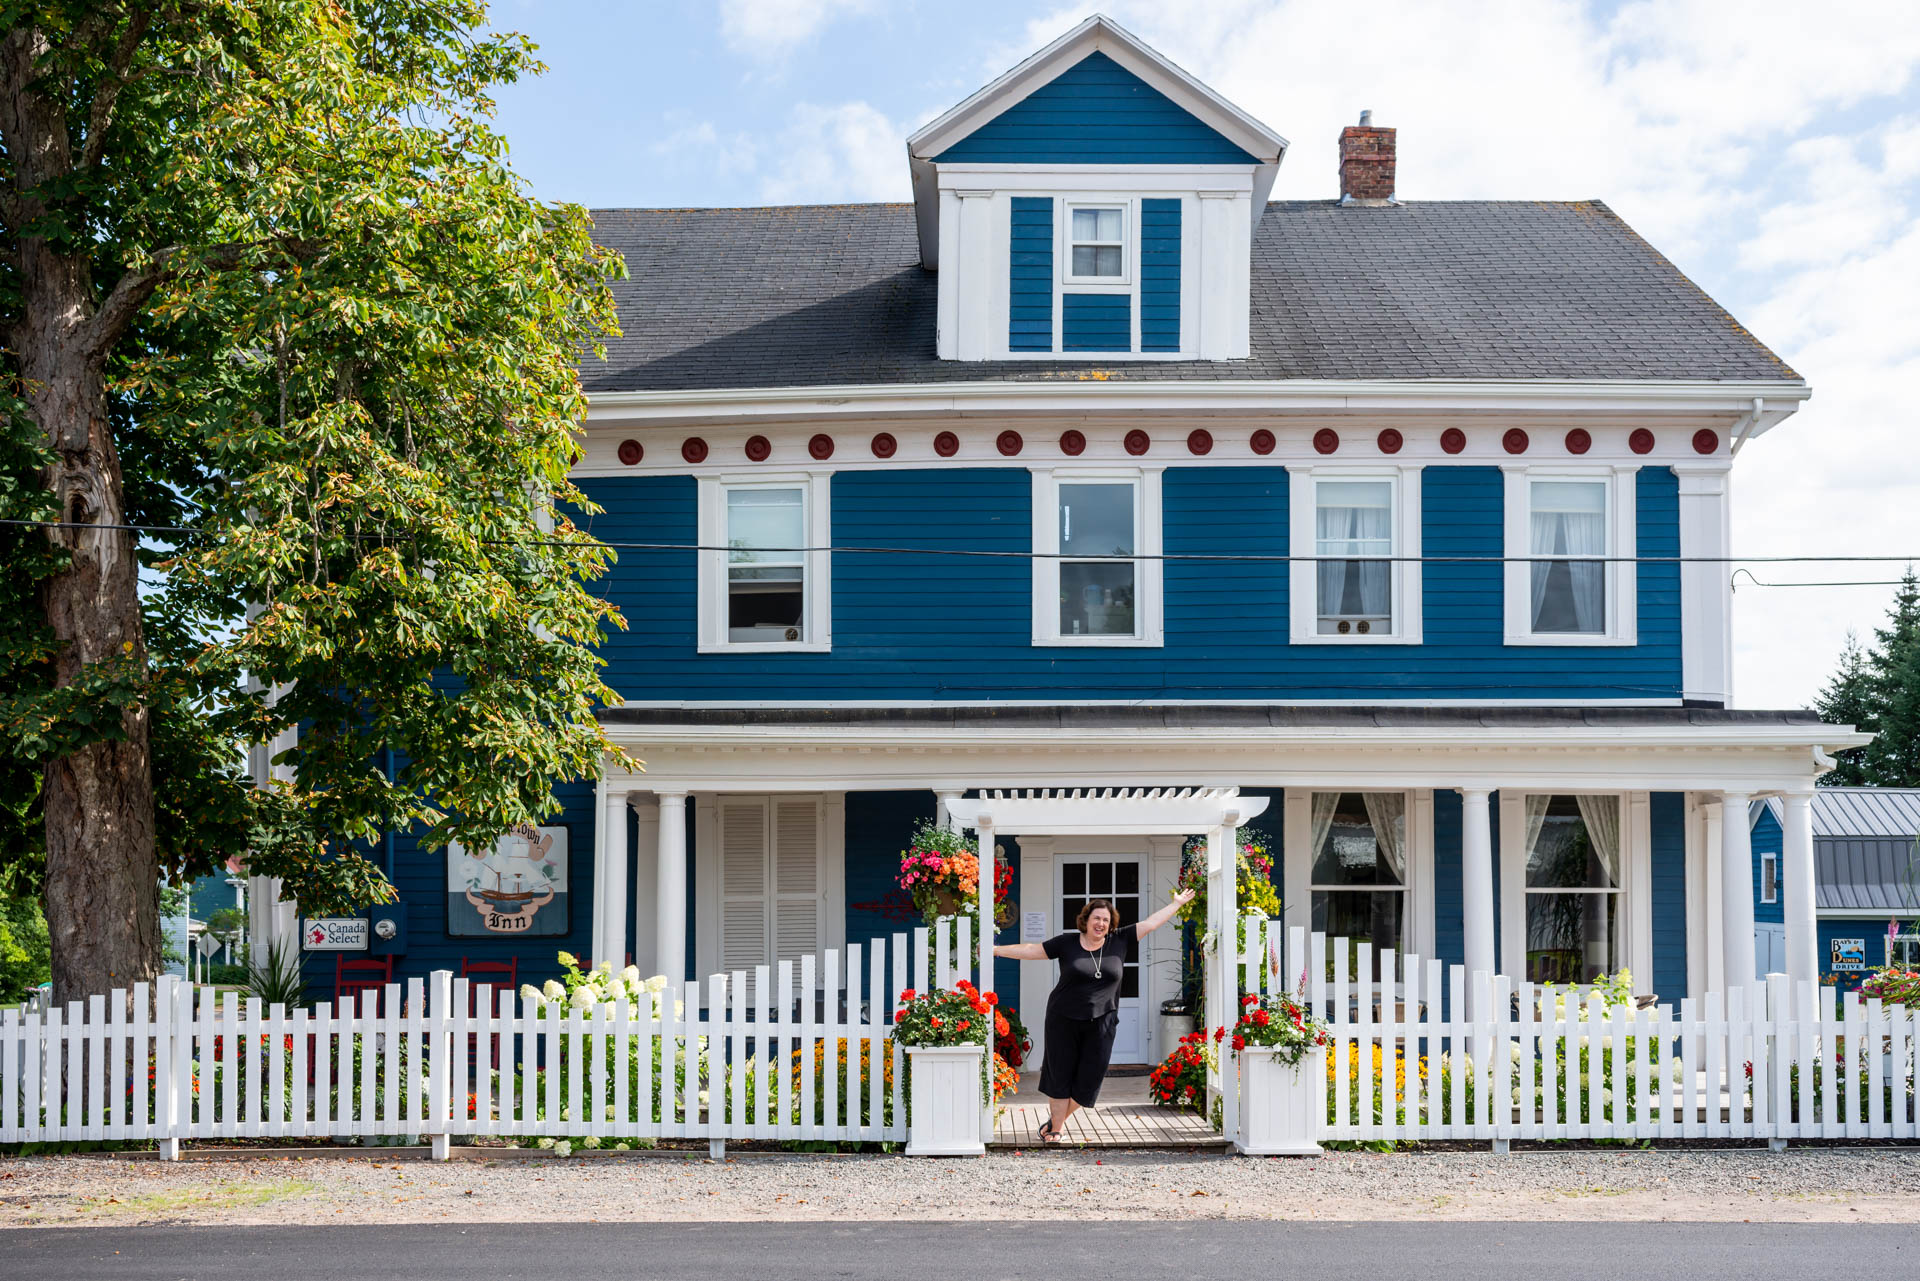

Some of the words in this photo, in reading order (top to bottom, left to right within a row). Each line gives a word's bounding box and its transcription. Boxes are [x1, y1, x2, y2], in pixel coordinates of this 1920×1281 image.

[488, 912, 527, 929] Inn
[328, 922, 366, 933] Canada
[328, 933, 360, 944] Select
